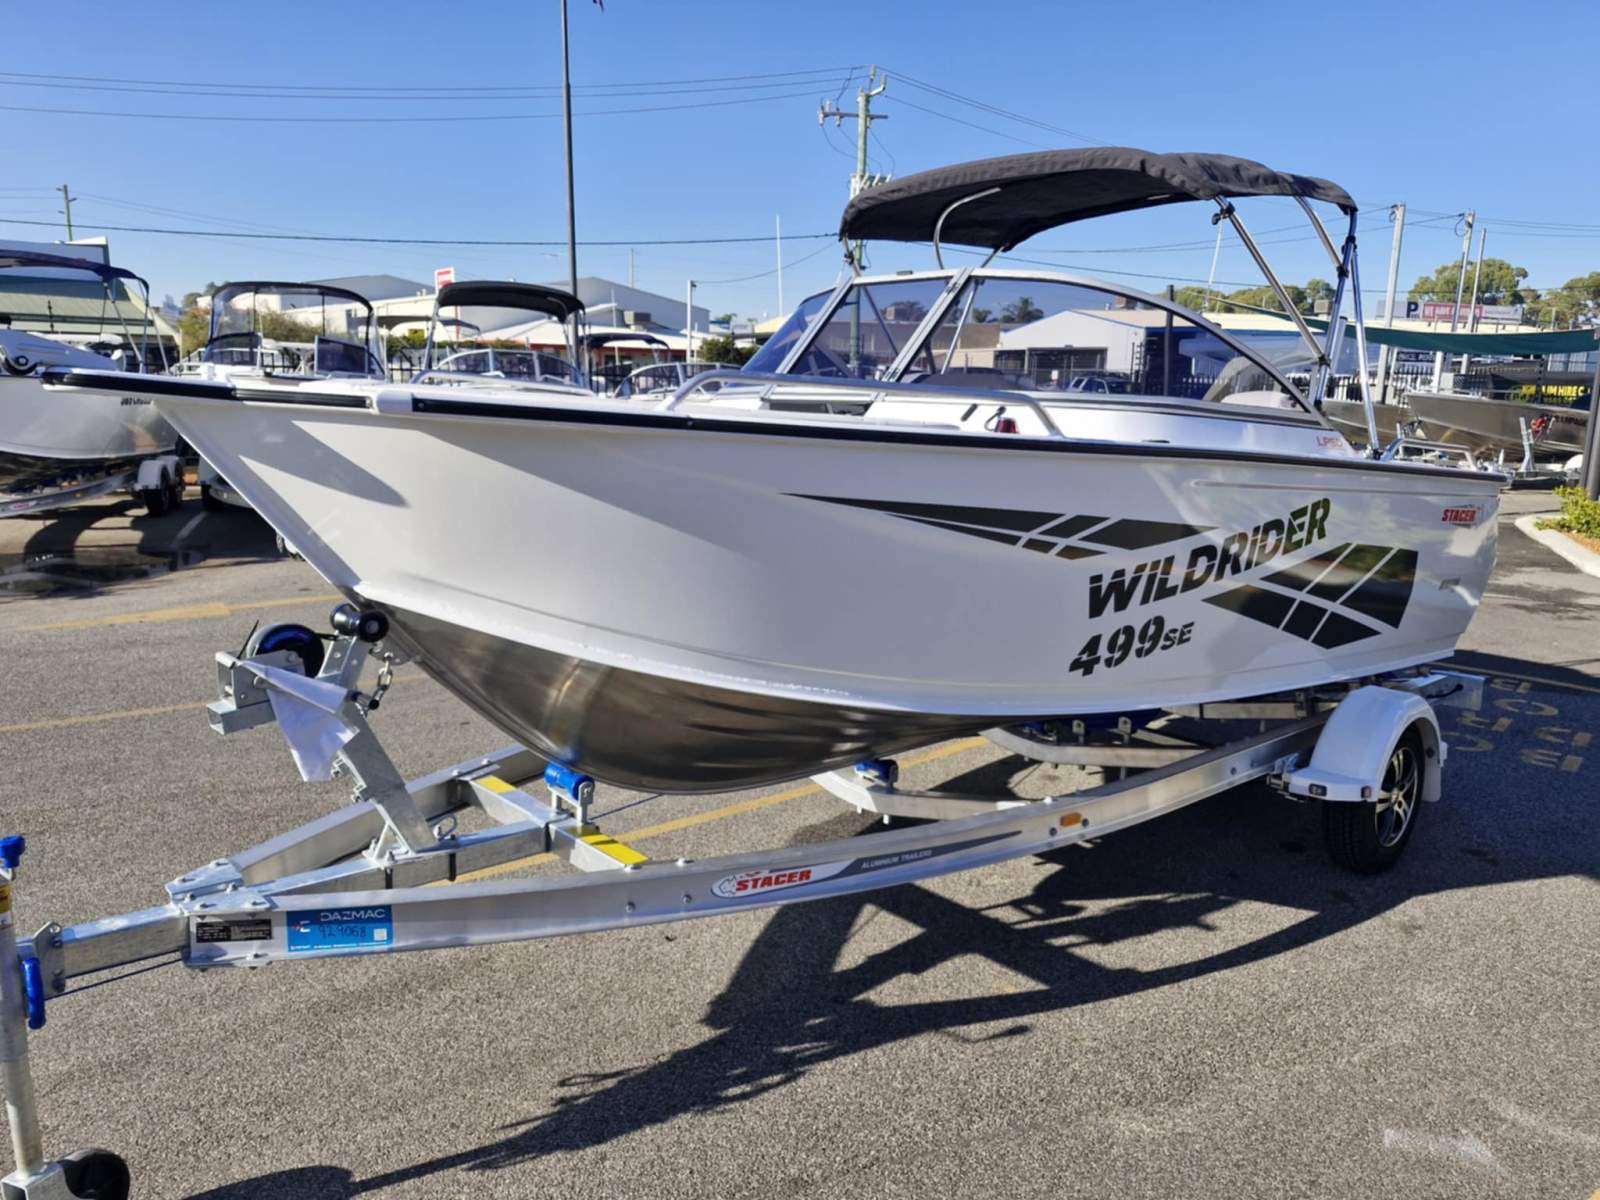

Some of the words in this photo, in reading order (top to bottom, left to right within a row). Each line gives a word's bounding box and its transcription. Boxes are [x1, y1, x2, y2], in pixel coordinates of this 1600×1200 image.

[1089, 498, 1331, 619] WILDRIDER
[736, 869, 812, 892] STACER
[320, 909, 385, 921] DAZMAC
